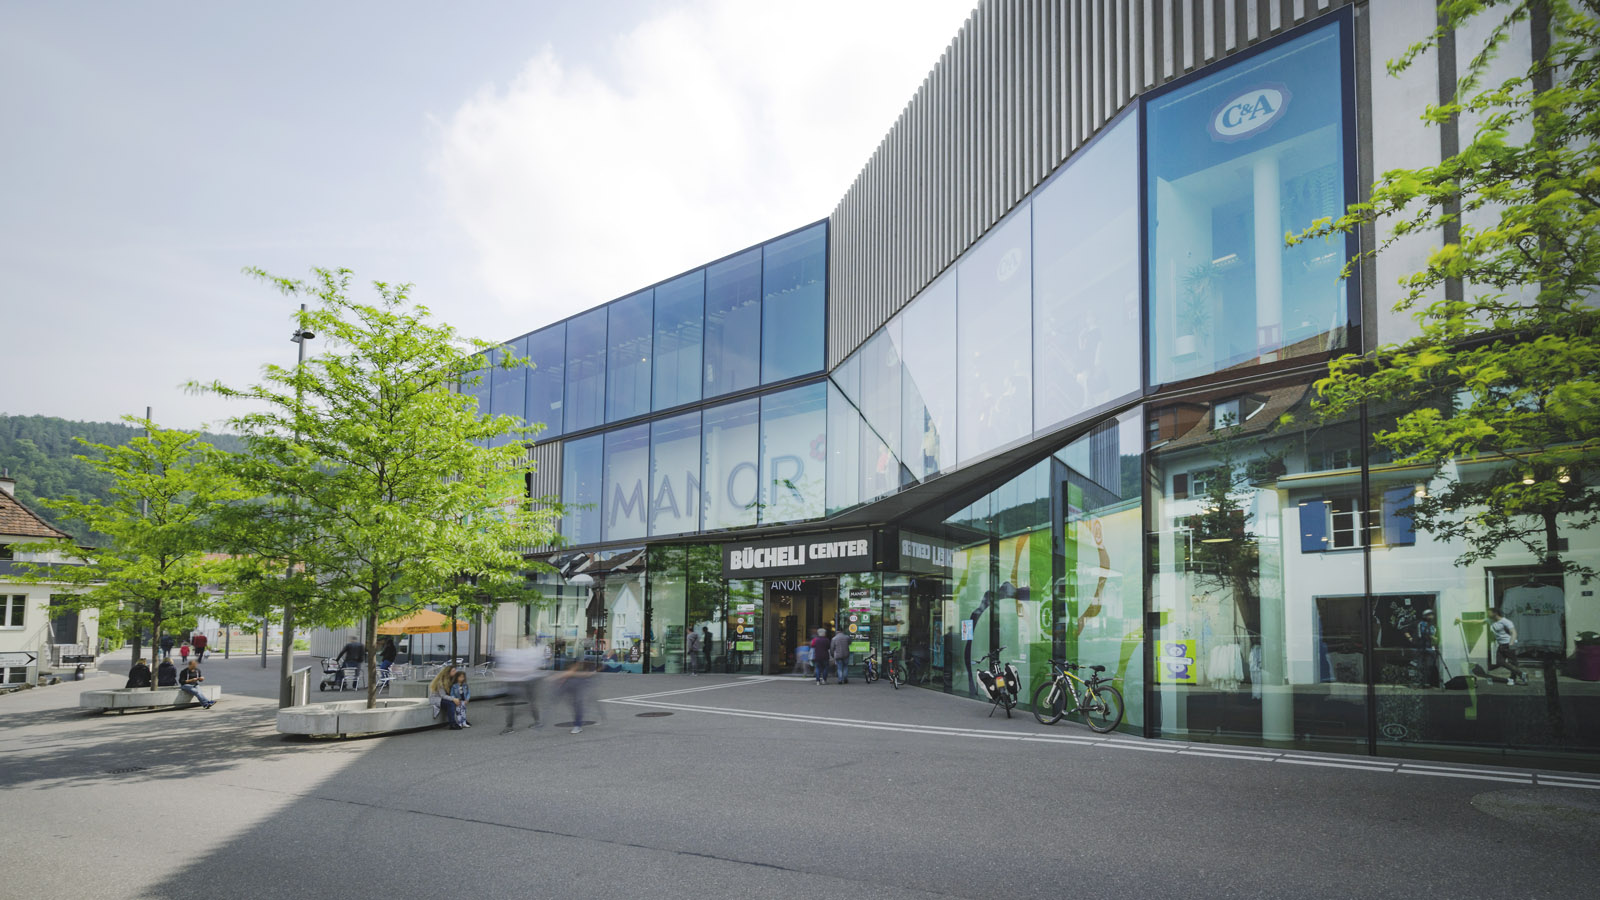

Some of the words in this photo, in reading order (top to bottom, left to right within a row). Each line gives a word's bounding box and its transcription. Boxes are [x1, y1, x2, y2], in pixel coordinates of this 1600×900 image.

[1222, 94, 1276, 128] C&A
[610, 454, 805, 529] MANOR
[730, 546, 806, 570] BÜCHELI
[809, 539, 868, 560] CENTER
